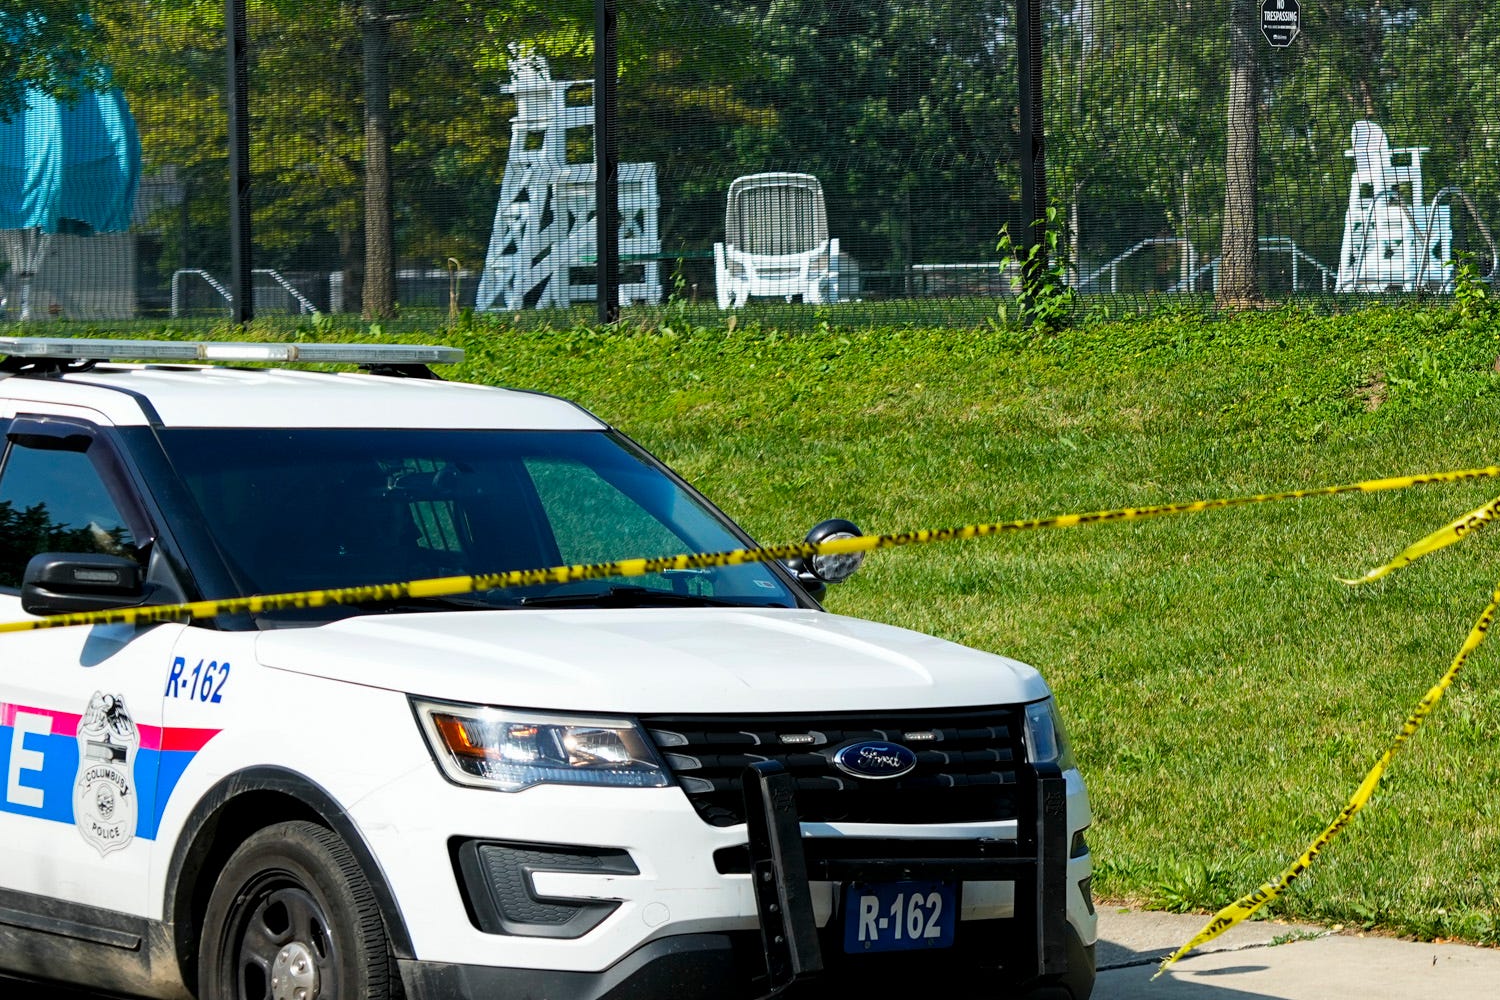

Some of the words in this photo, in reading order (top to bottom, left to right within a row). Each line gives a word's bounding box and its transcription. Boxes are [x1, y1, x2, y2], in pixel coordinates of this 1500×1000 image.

[1276, 0, 1285, 9] NO
[1263, 11, 1297, 21] TRESPASSING
[165, 656, 231, 704] R-162
[7, 711, 53, 809] E
[857, 746, 902, 768] Ford
[86, 768, 125, 788] COLUMBUS
[92, 822, 121, 840] POLICE
[858, 892, 943, 941] R-162
